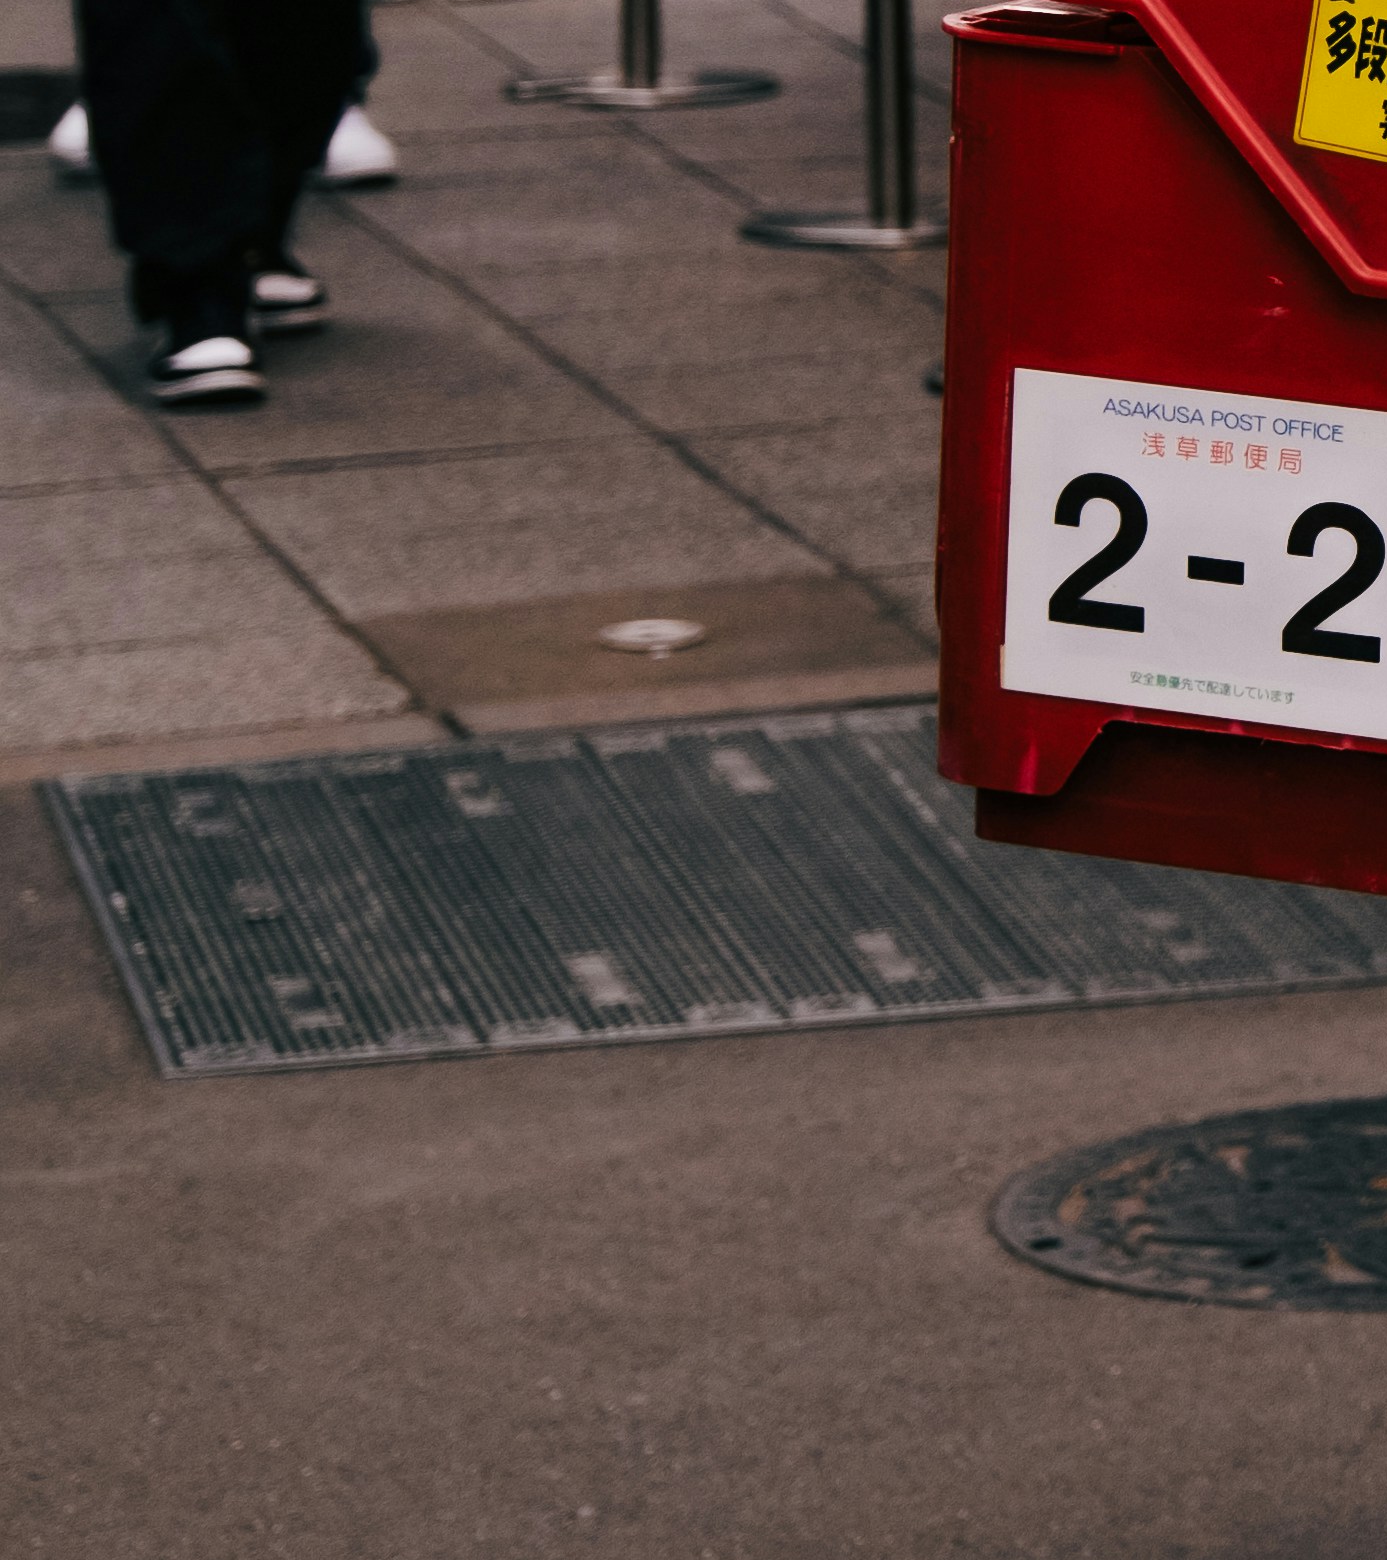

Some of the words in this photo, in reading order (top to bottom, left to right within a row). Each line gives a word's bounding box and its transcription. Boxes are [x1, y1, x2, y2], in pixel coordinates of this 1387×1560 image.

[1102, 397, 1205, 427] ASAKUSA
[1210, 409, 1267, 433] POST
[1271, 416, 1345, 443] OFFICE
[1140, 430, 1303, 475] 浅草郵便局
[1047, 471, 1387, 664] 2-2
